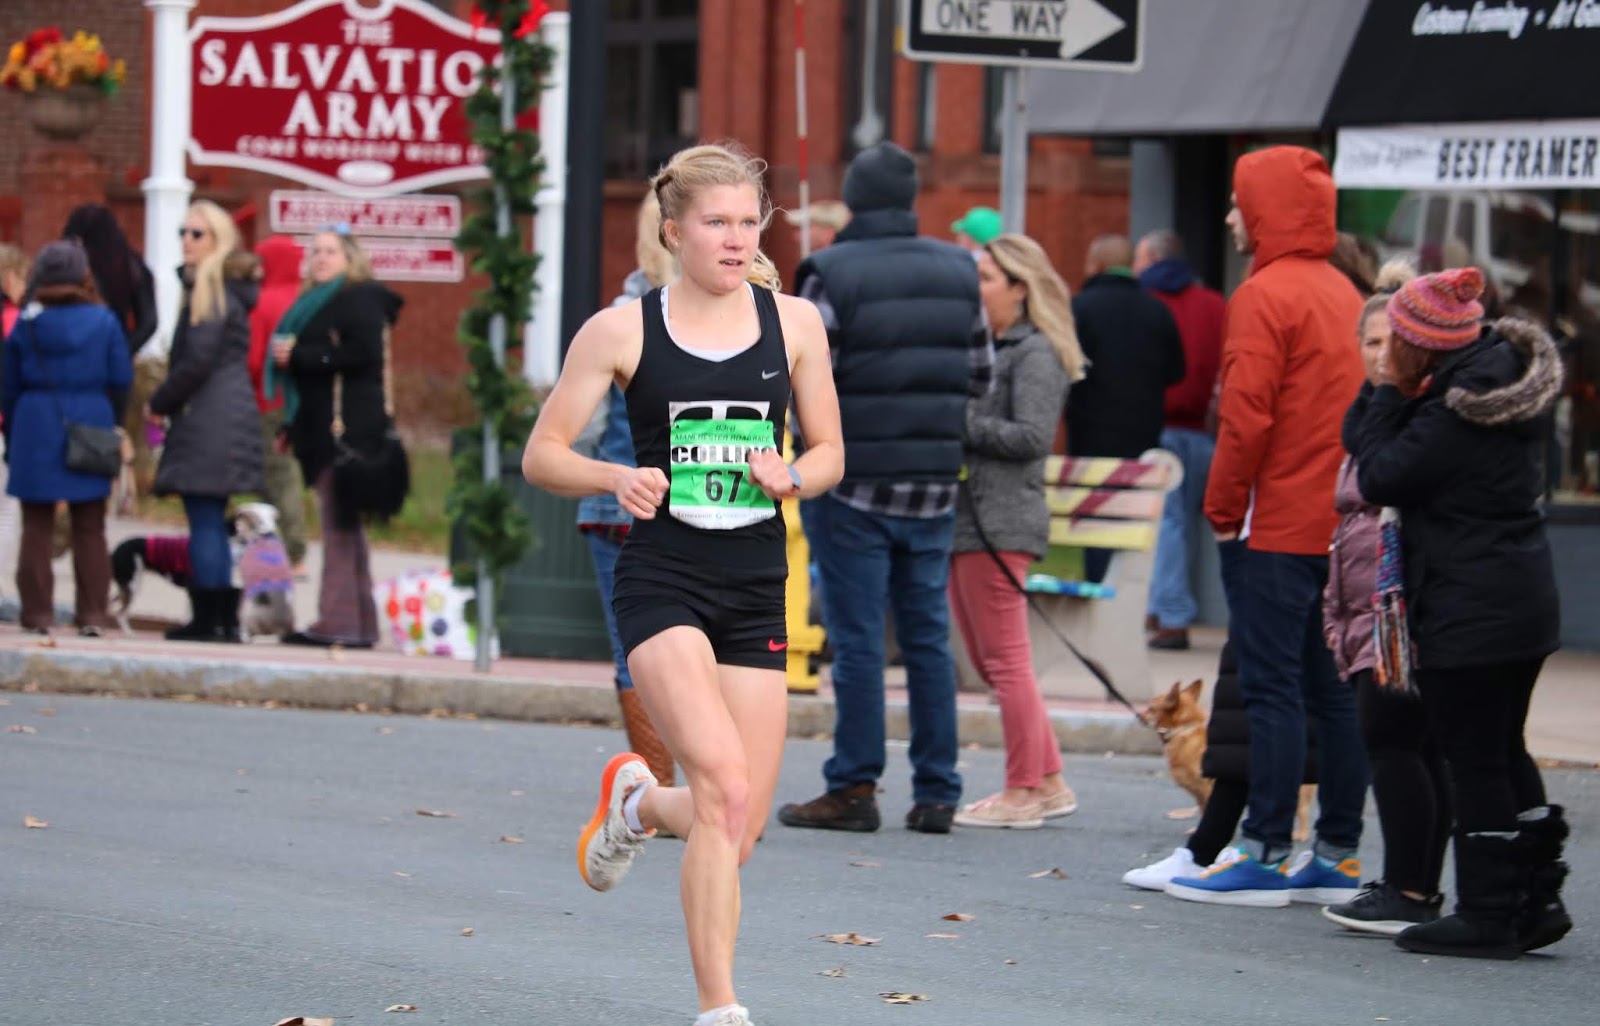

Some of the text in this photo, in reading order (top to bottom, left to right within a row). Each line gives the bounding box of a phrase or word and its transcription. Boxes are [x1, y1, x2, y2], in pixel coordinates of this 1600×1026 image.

[340, 20, 393, 46] THE
[937, 0, 1067, 35] ONE WAY
[199, 39, 505, 98] SALVATIO
[282, 90, 450, 142] ARMY
[1437, 138, 1497, 182] BEST
[671, 446, 768, 463] COLLI
[705, 470, 744, 504] 67
